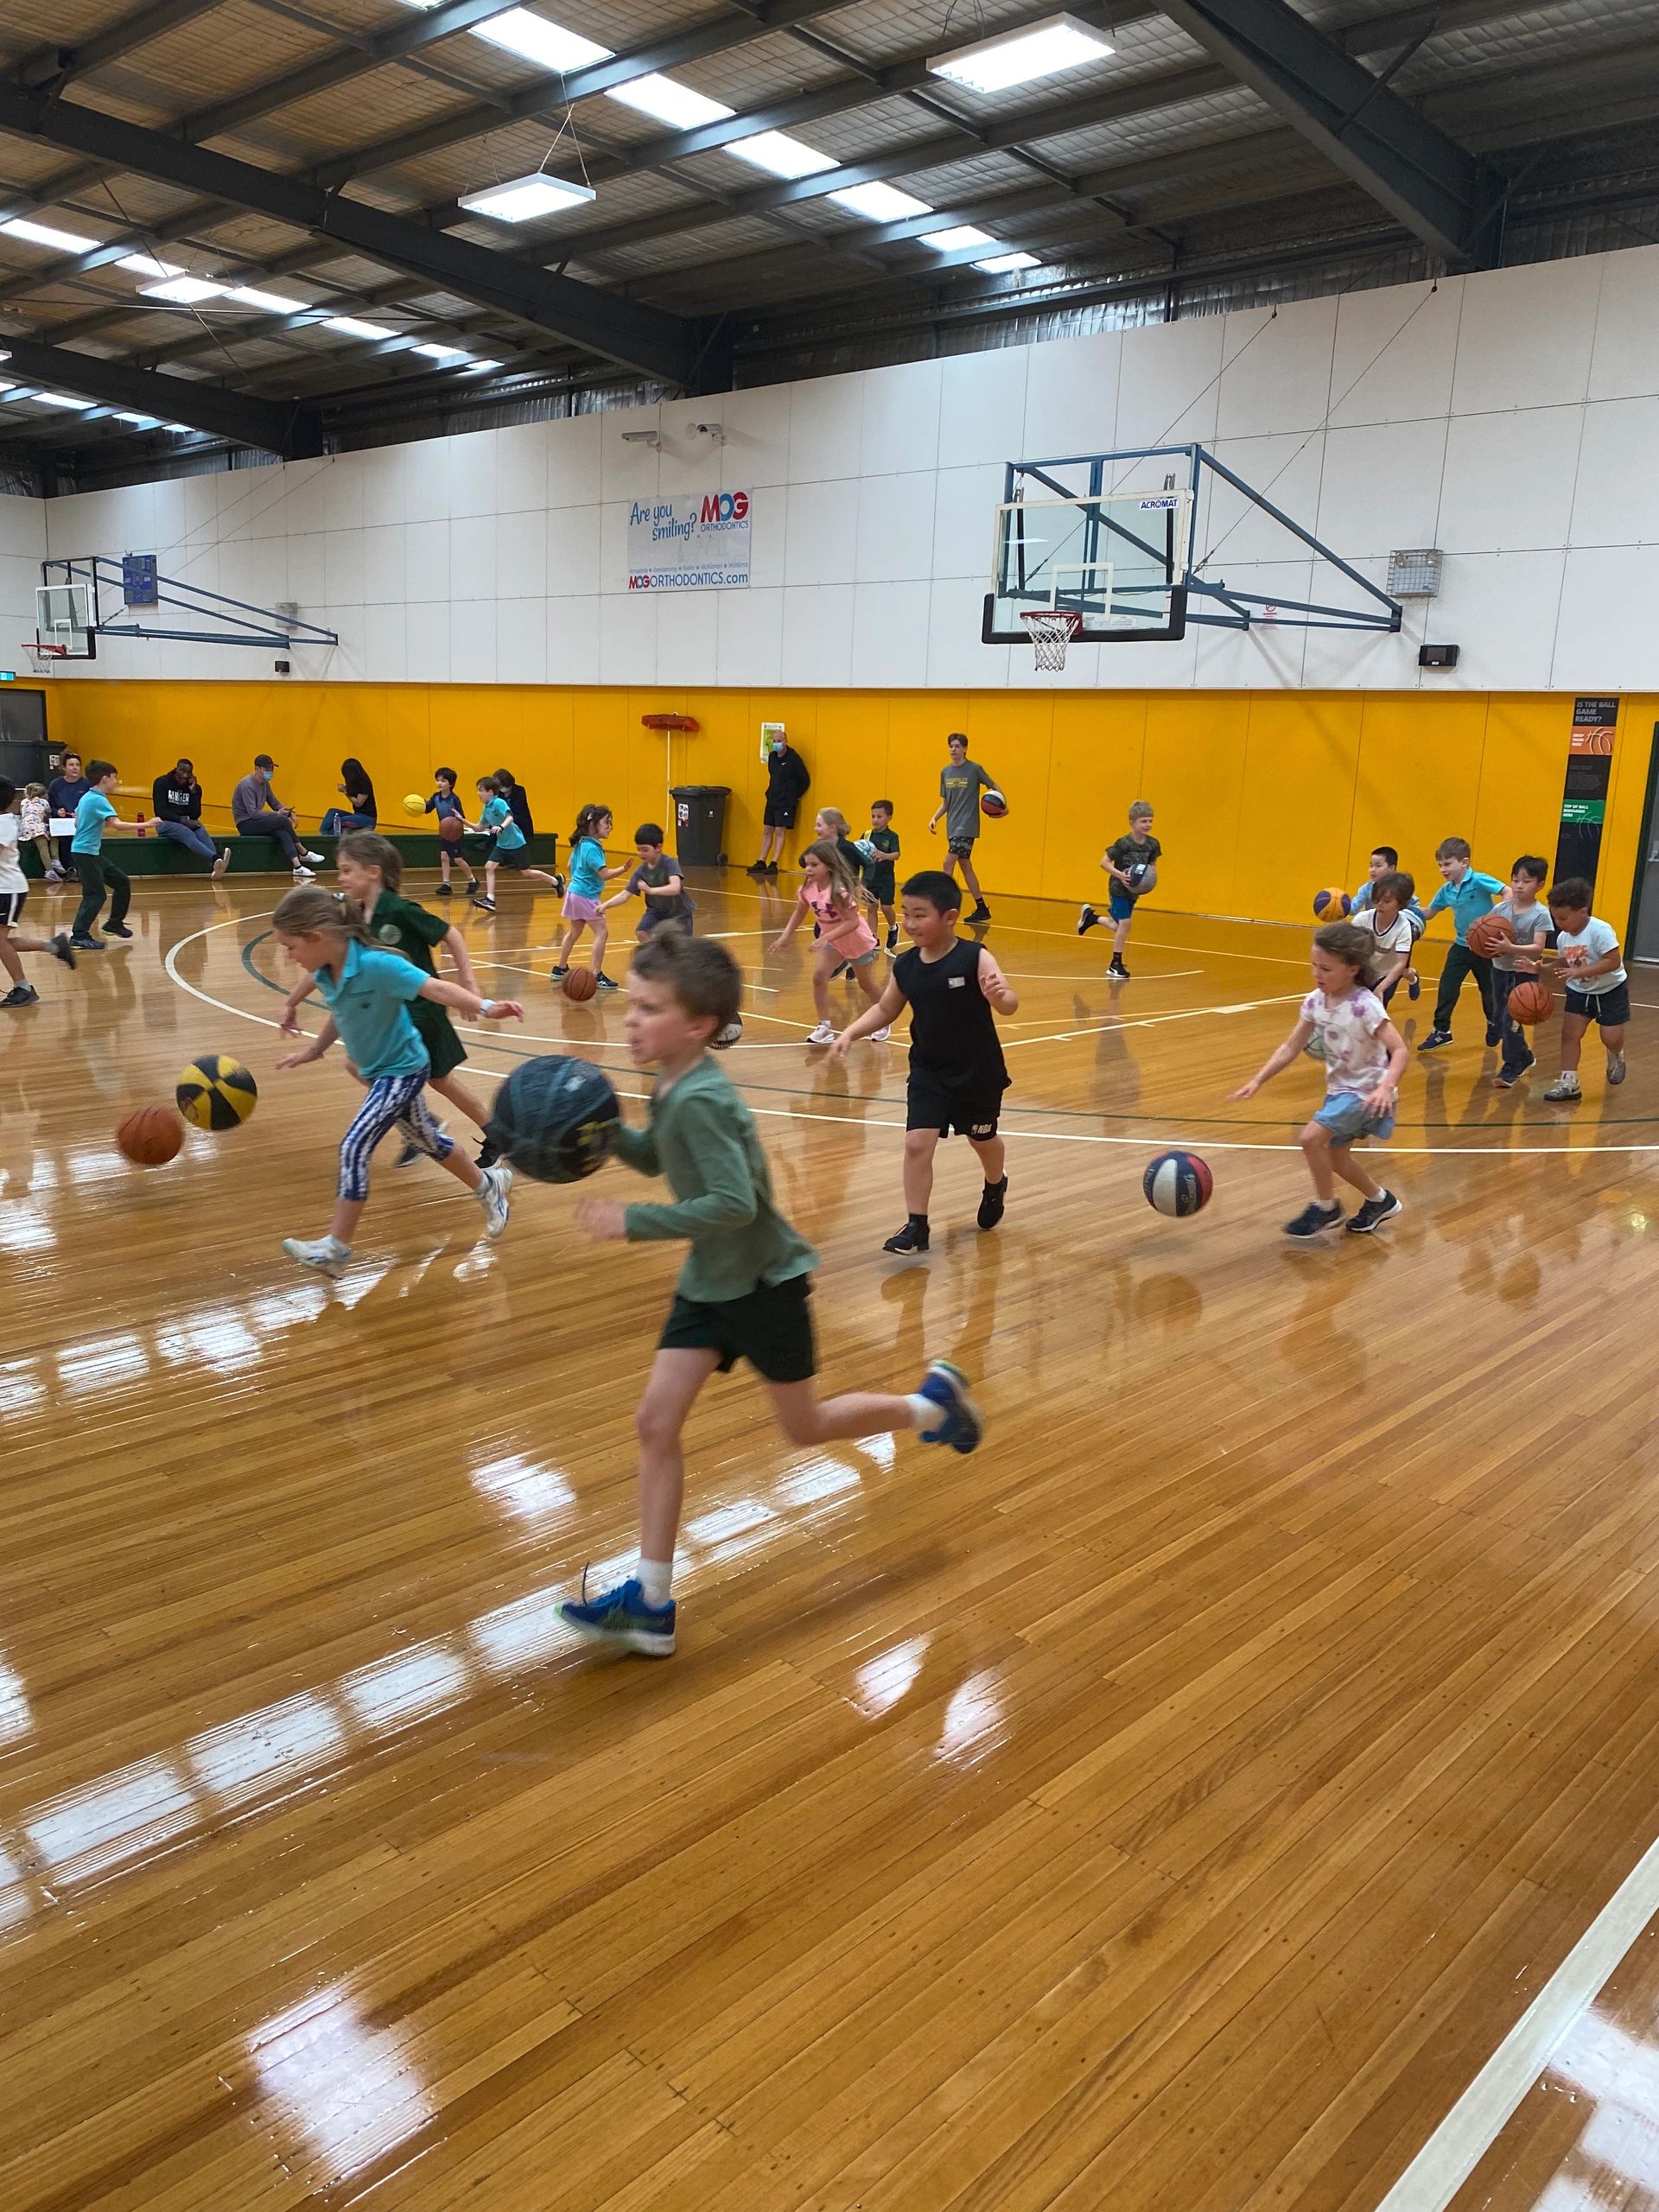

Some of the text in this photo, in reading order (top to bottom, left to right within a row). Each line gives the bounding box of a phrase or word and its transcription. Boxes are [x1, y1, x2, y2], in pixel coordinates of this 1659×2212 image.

[630, 502, 672, 526] Are you
[700, 491, 749, 524] MOG
[1141, 499, 1178, 509] ACROMAT
[652, 512, 697, 541] smiling?
[701, 520, 749, 532] ORTHODONTICS
